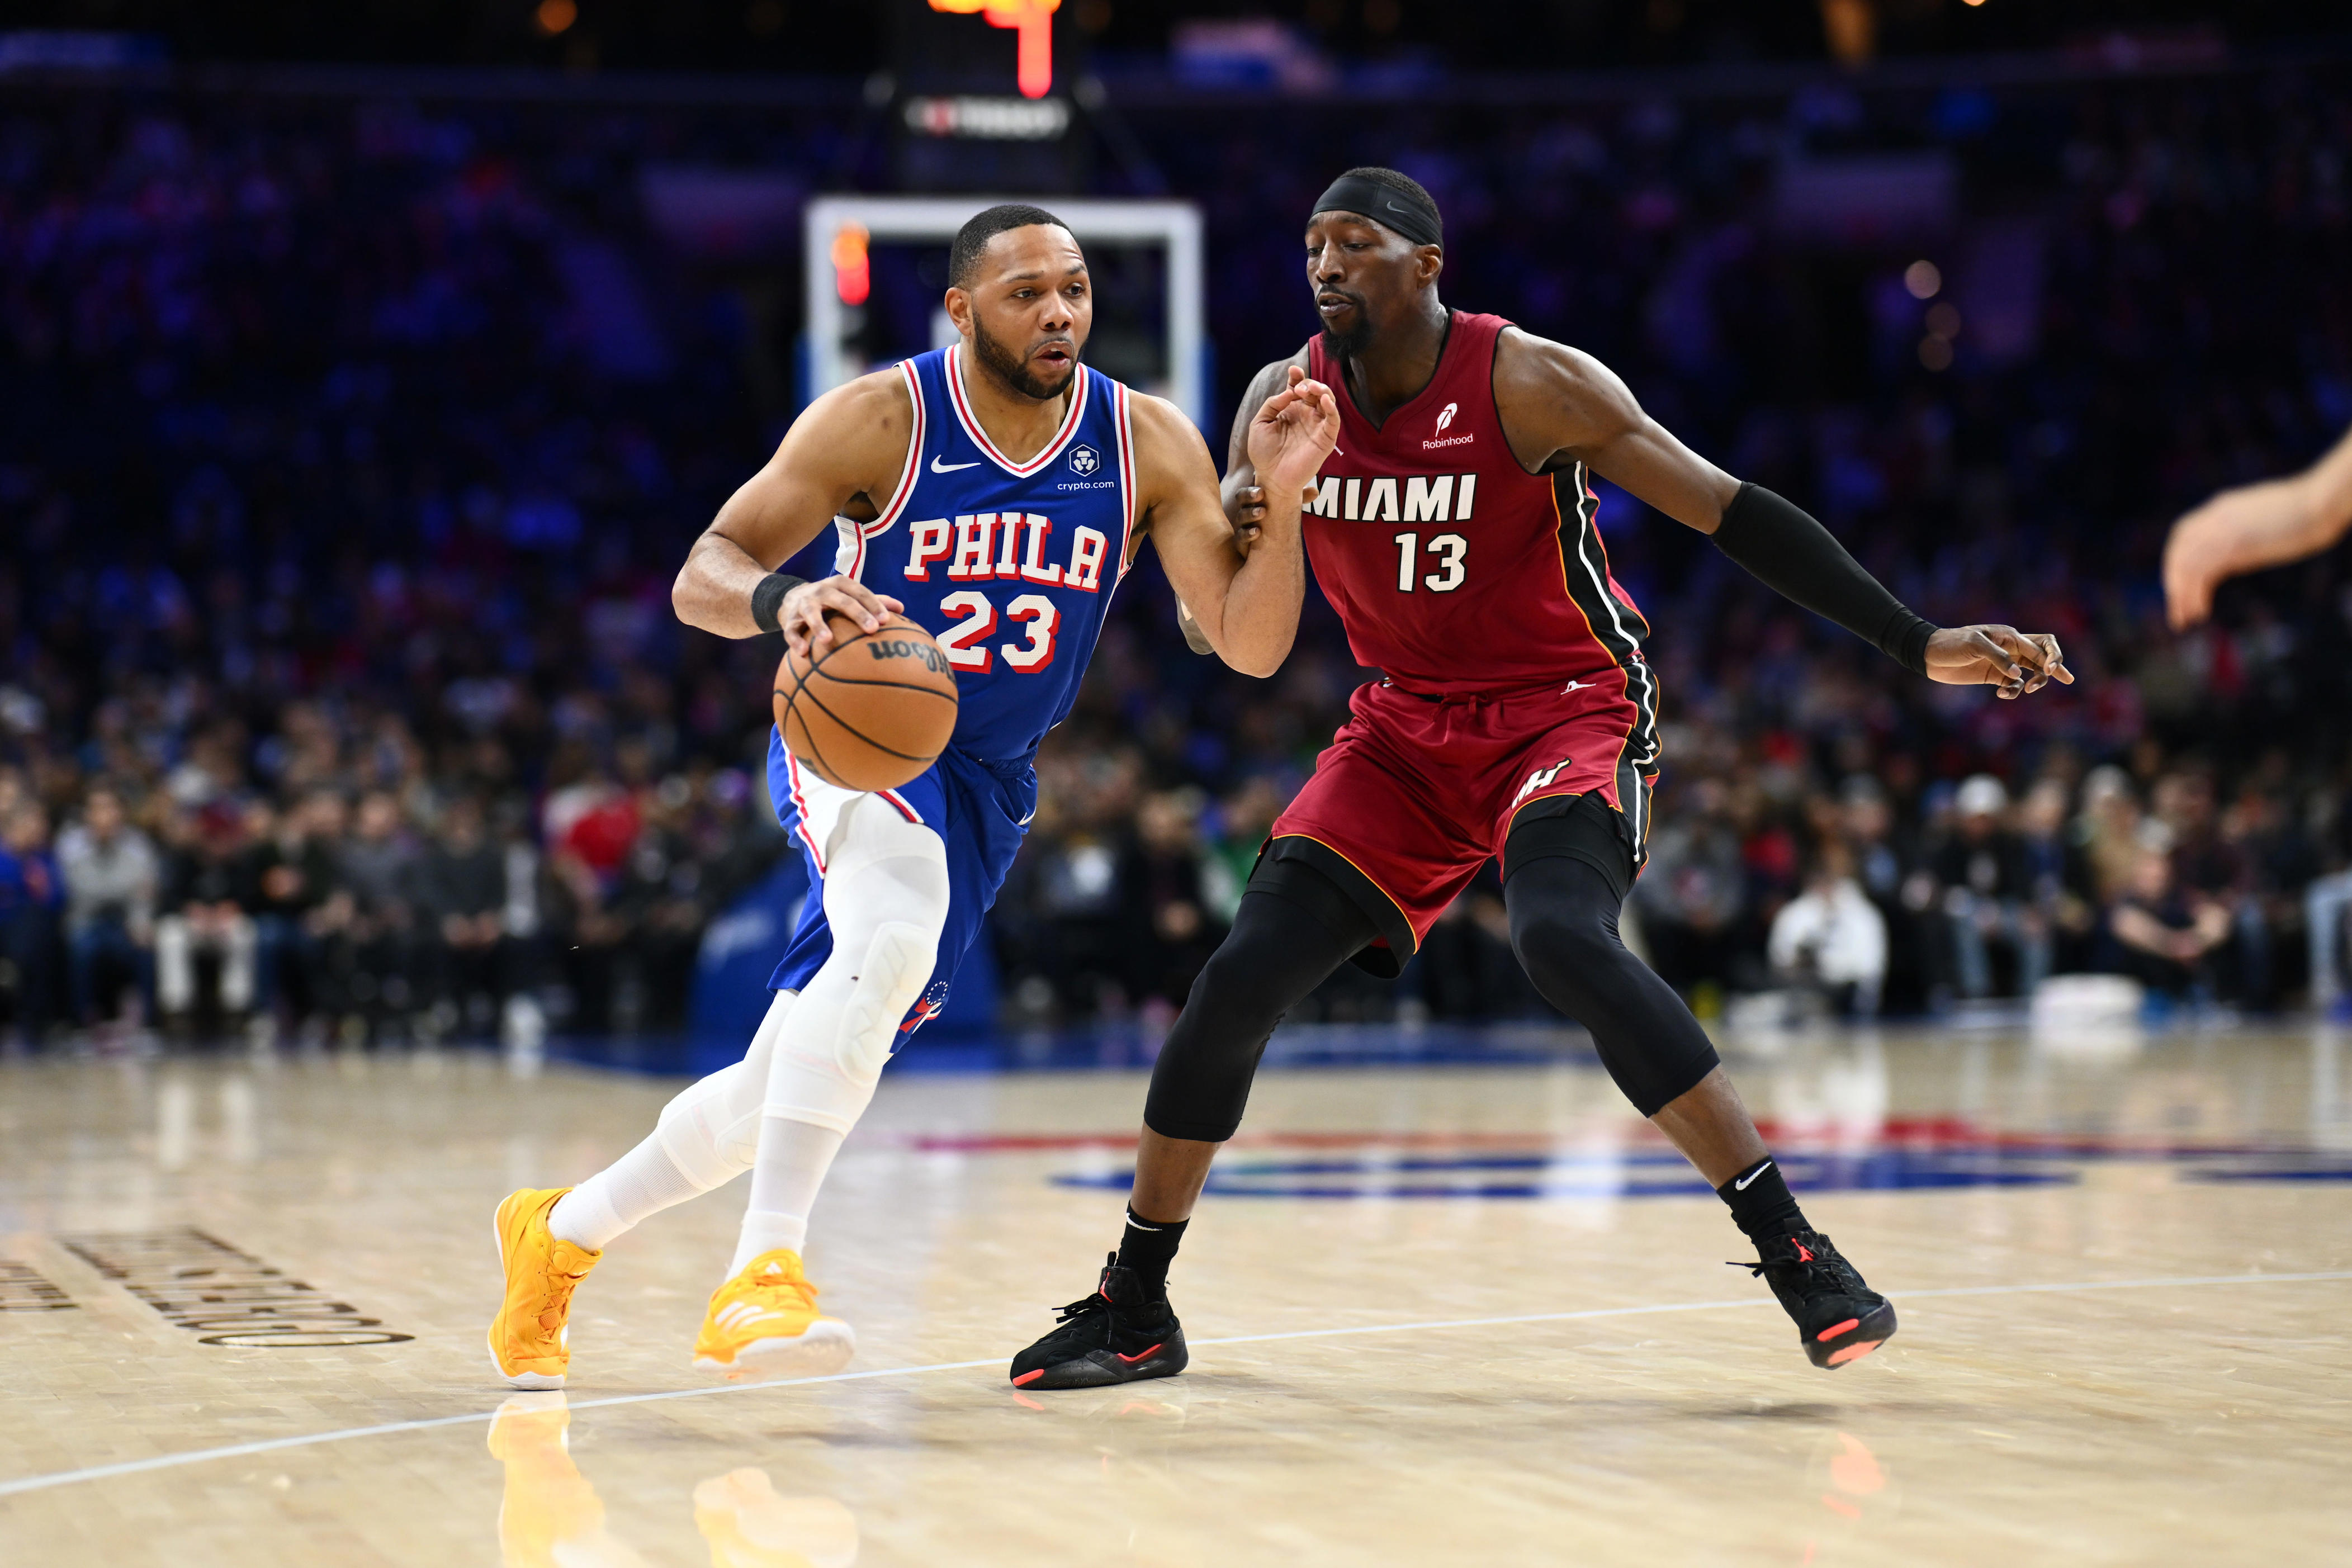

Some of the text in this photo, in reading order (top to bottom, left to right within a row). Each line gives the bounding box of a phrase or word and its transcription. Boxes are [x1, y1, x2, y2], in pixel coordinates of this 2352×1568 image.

[1422, 433, 1473, 450] Robinhood
[1057, 481, 1114, 491] crypto.com
[1302, 473, 1477, 522] MIAMI
[903, 512, 1109, 593] PHILA
[1394, 532, 1468, 593] 13
[936, 590, 1061, 674] 23
